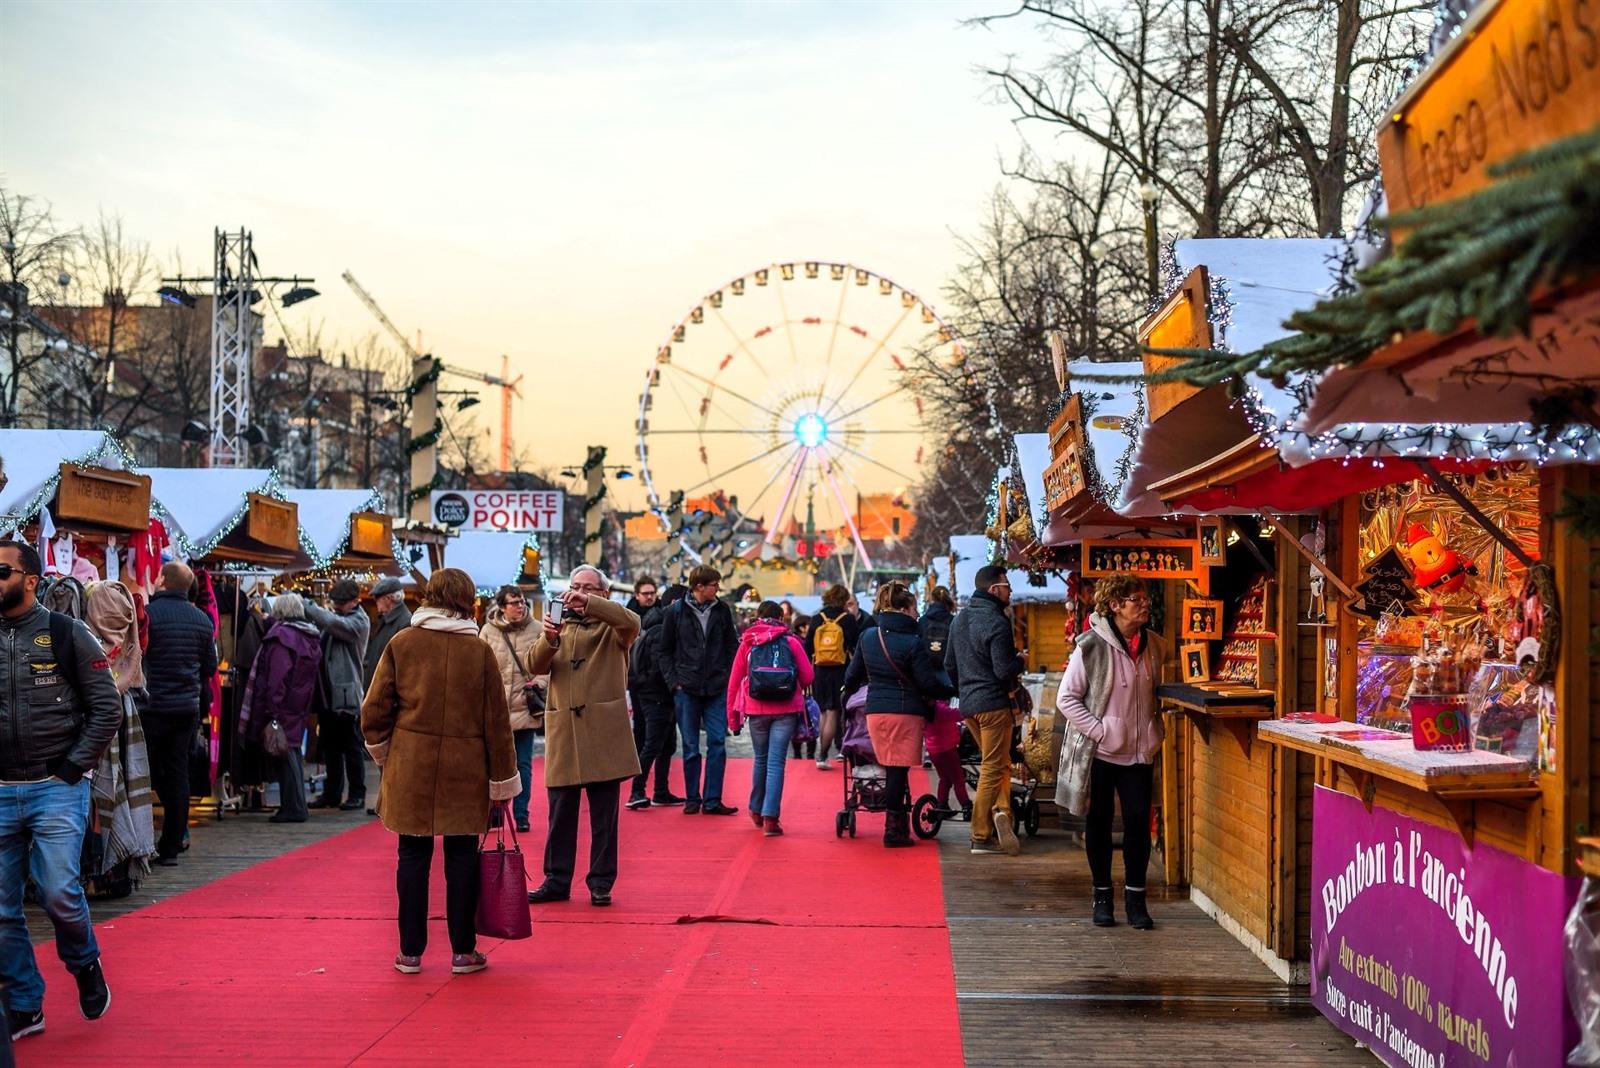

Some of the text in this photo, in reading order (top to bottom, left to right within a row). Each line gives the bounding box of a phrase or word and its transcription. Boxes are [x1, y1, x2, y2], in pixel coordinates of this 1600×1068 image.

[474, 494, 557, 508] COFFEE
[474, 510, 557, 528] POINT
[1322, 827, 1518, 1029] Bonbon à l'ancienne
[1326, 976, 1346, 1017] Sucre
[1350, 998, 1373, 1032] cuit
[1375, 1006, 1382, 1039] à
[1384, 1011, 1435, 1068] l'ancienne
[1338, 936, 1354, 974] Aux
[1356, 954, 1398, 999] extraits
[1401, 972, 1433, 1023] 100%
